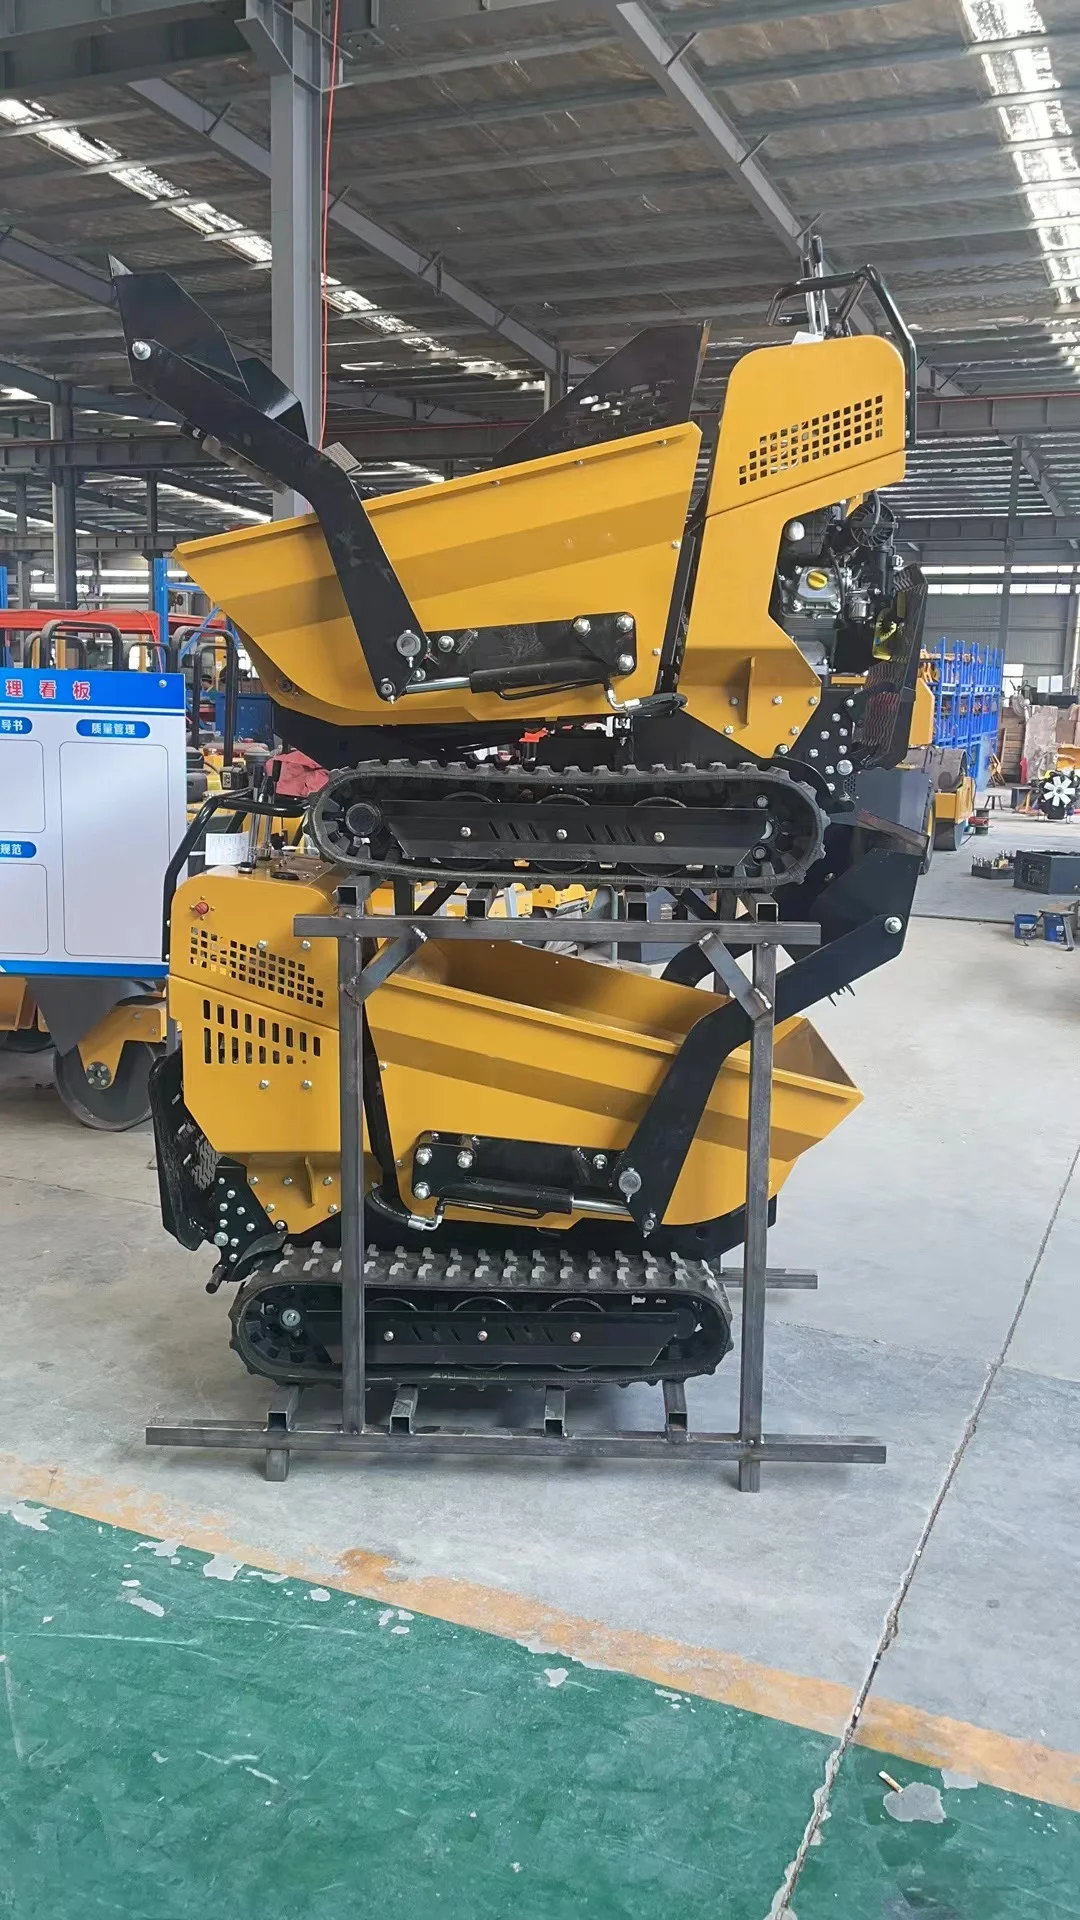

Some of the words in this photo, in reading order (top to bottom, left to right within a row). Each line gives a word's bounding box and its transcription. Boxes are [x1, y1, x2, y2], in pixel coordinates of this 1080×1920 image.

[1, 719, 23, 731] 导书
[91, 722, 136, 735] 质量管理
[0, 844, 21, 855] 规范
